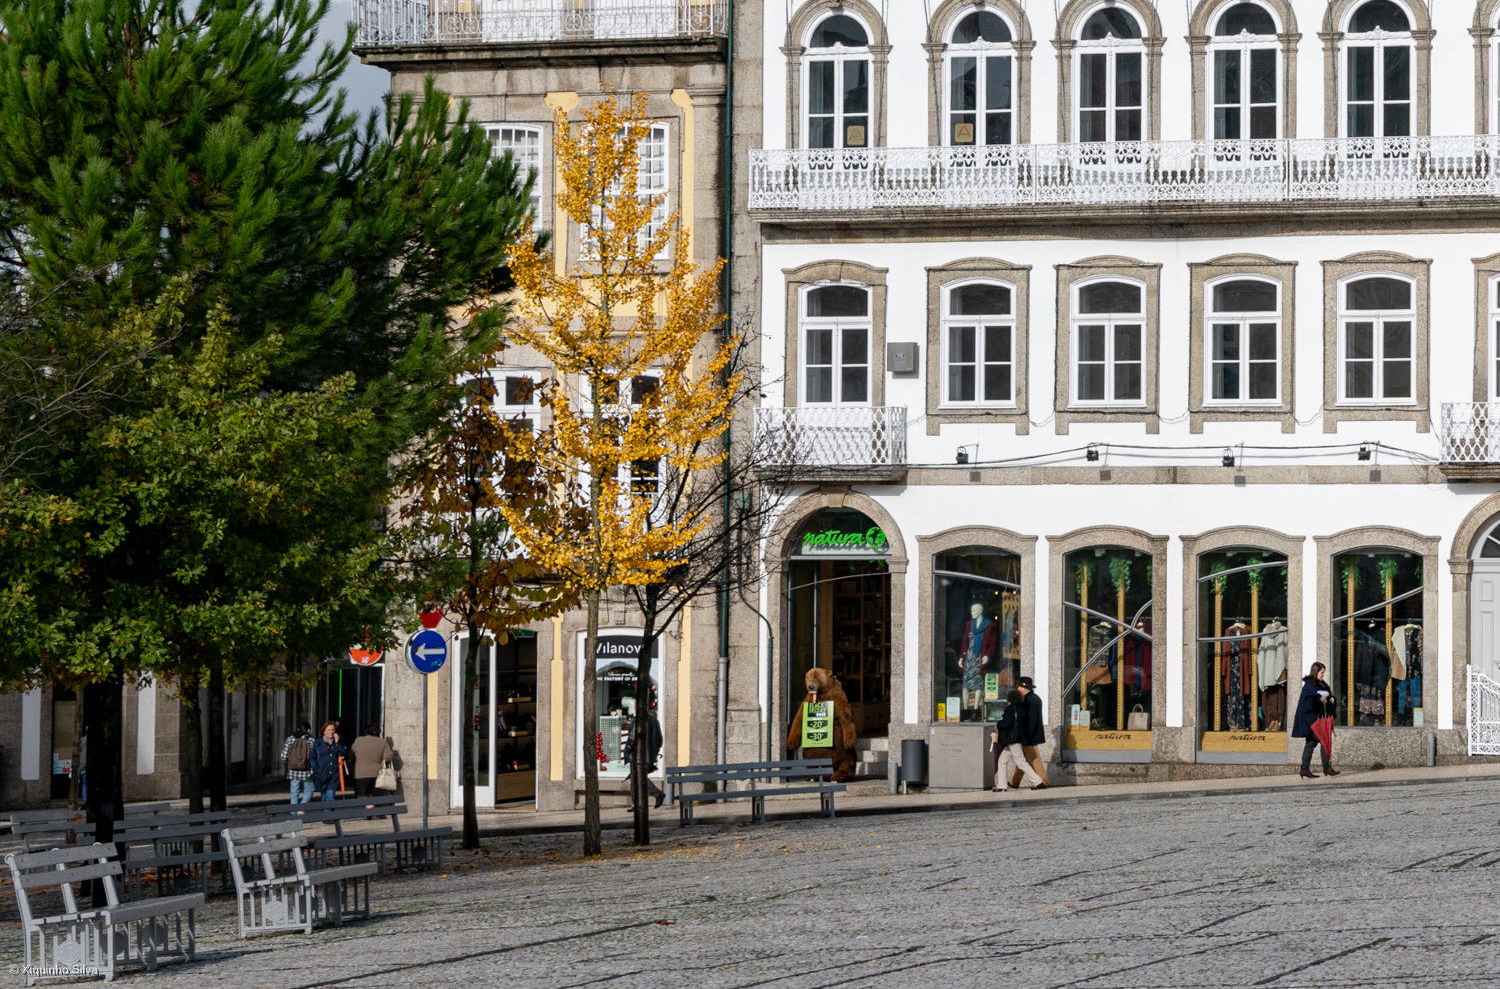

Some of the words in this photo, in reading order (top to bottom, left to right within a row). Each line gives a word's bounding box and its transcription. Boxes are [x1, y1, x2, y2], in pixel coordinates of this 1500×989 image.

[848, 126, 864, 142] A
[956, 124, 972, 139] A
[803, 529, 866, 546] natura
[596, 641, 642, 654] Vilanov
[1094, 732, 1132, 741] natura
[1228, 734, 1267, 742] natura
